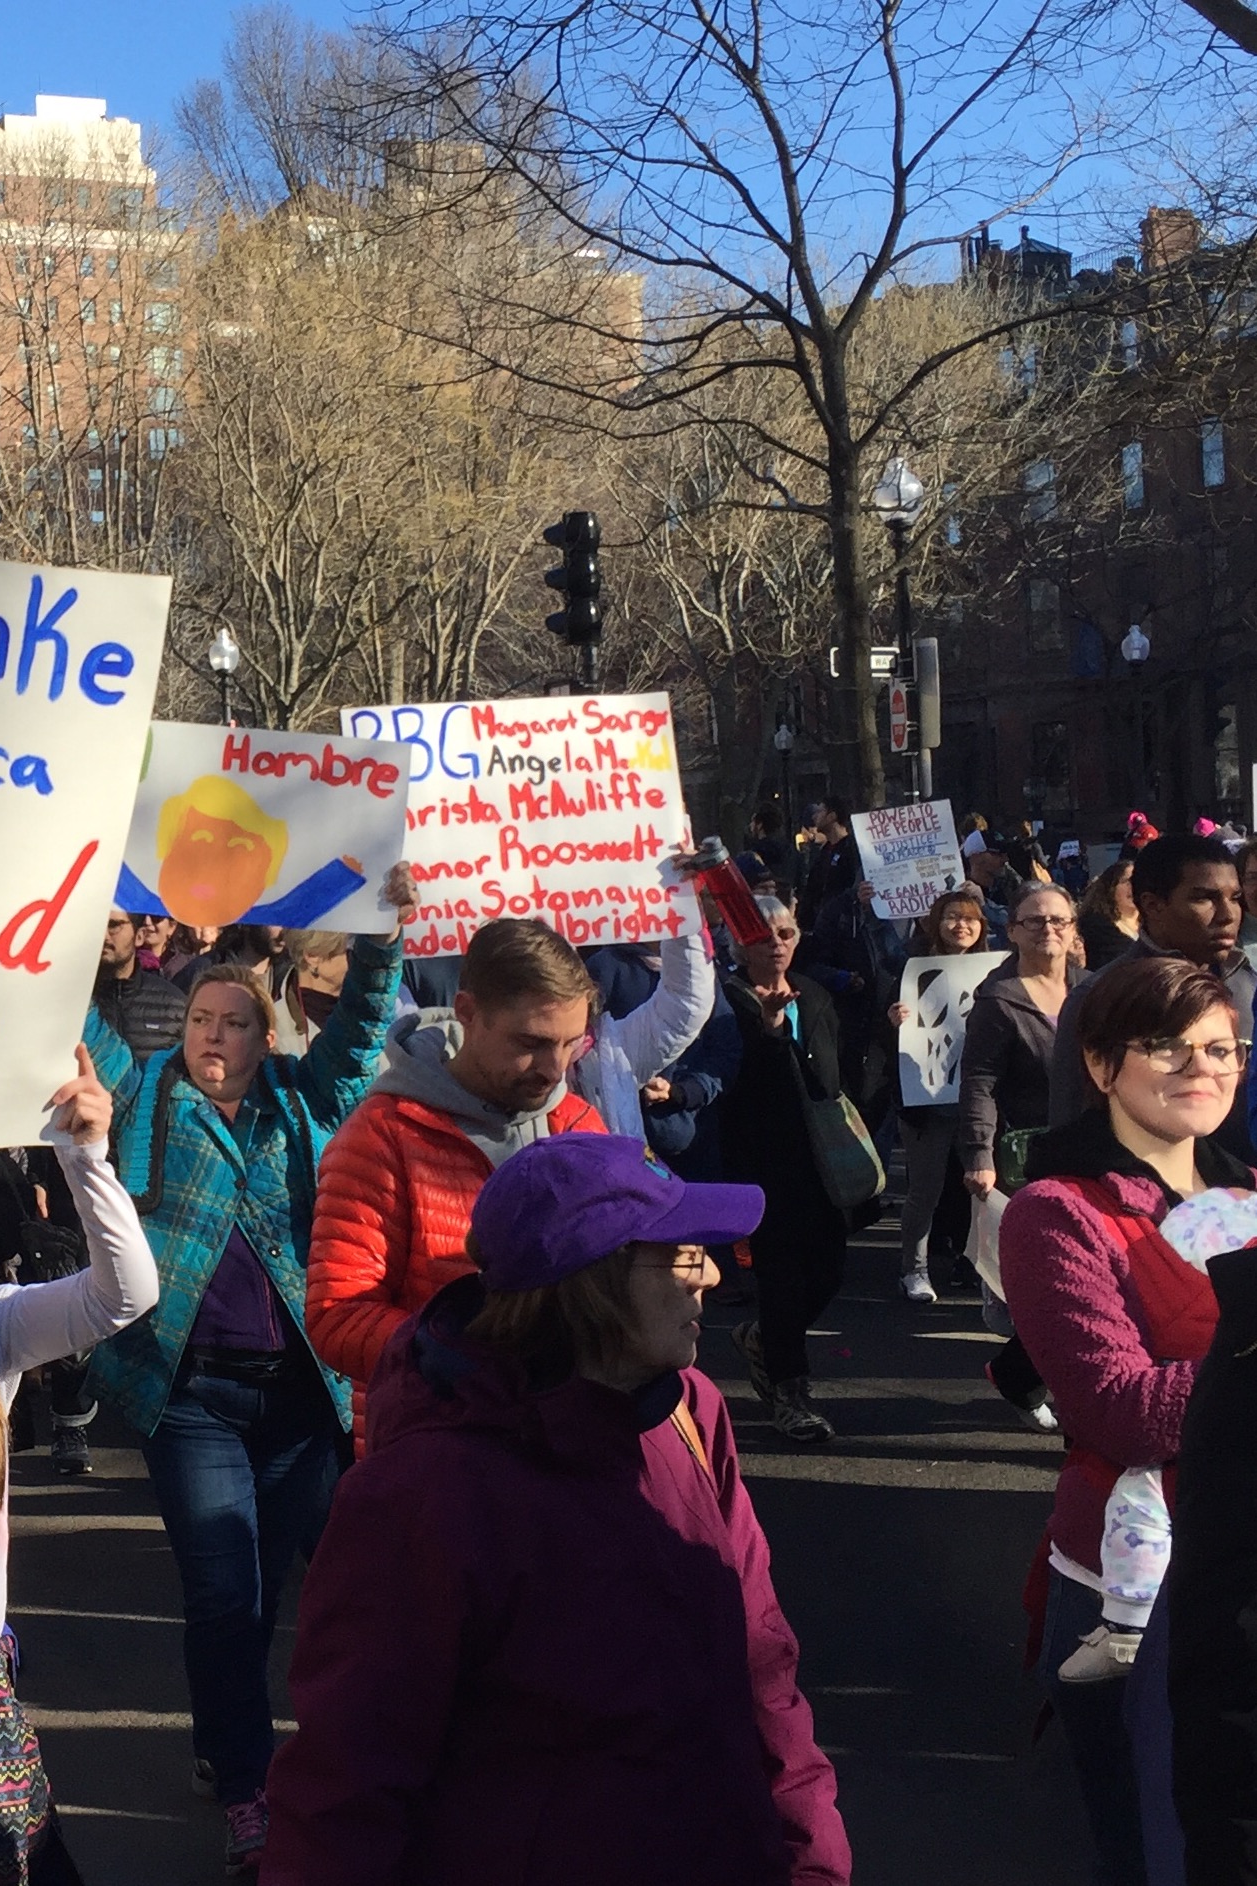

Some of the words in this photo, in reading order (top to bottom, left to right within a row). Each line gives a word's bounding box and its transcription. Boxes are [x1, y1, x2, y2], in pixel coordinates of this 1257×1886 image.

[221, 734, 399, 798] Hombre
[488, 740, 593, 786] Angela
[406, 785, 502, 830] rista
[509, 772, 667, 822] McAuliffe
[869, 807, 916, 825] POWER
[918, 803, 934, 818] TO
[866, 824, 891, 839] THE
[893, 814, 942, 835] PEOPLE
[409, 855, 491, 882] anor
[499, 823, 664, 871] Roosevelt
[403, 899, 477, 925] nia
[888, 895, 939, 914] RADIC
[403, 921, 479, 956] adel
[537, 907, 686, 944] lbright
